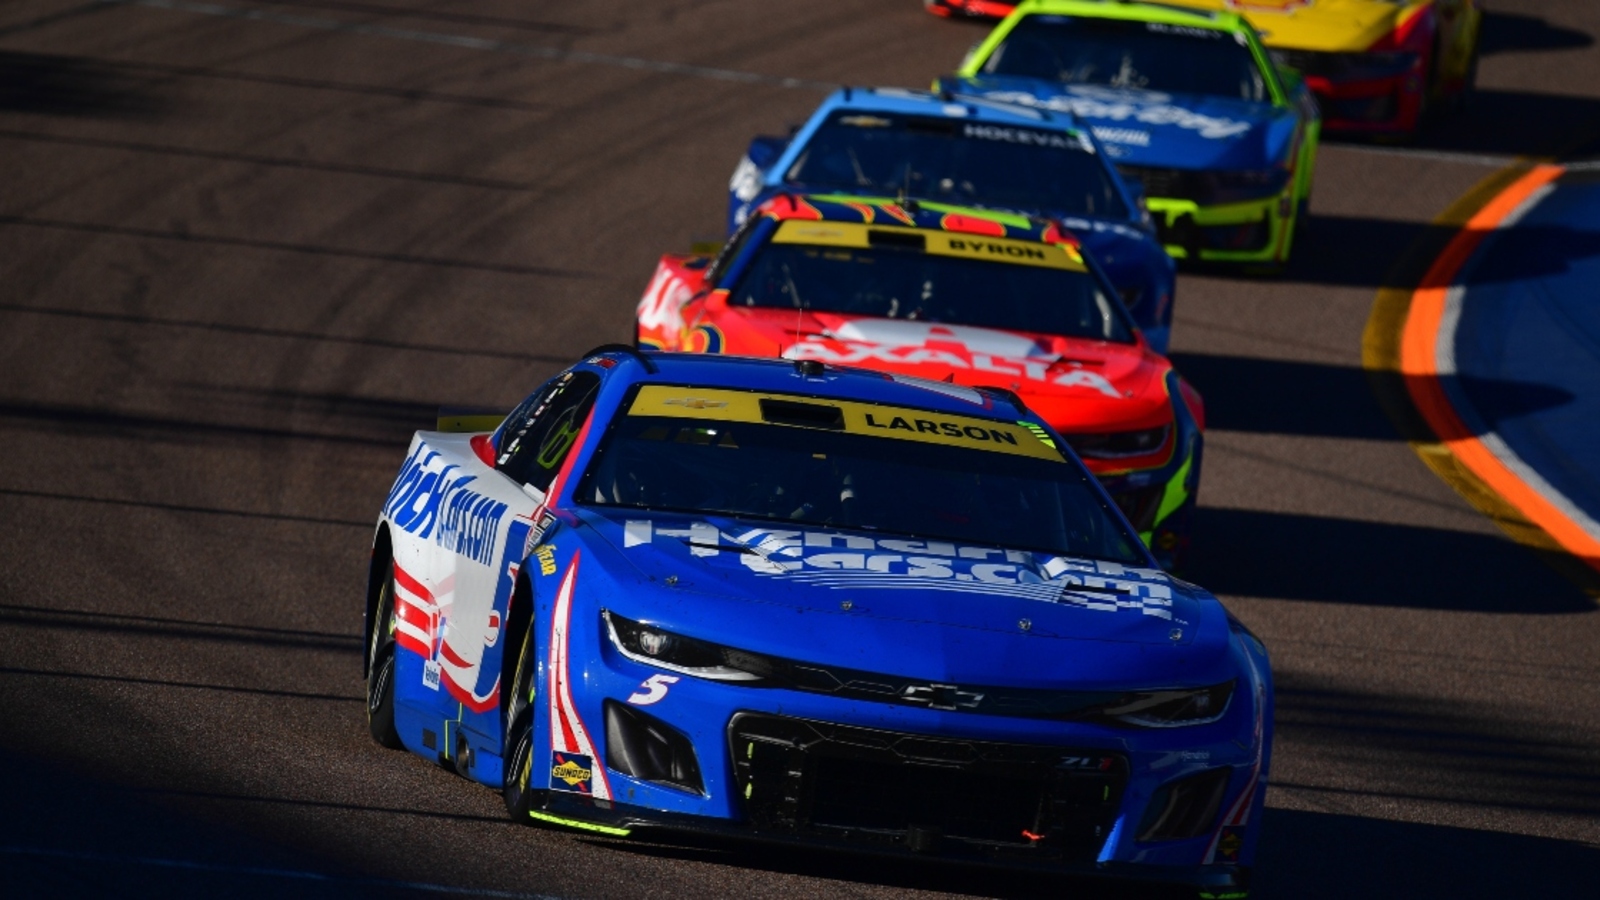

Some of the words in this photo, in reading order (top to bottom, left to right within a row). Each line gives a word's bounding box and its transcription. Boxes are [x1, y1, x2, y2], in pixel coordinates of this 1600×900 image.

[949, 238, 1045, 260] BYRON
[782, 342, 1123, 399] AXALTA
[865, 413, 1018, 445] LARSON
[627, 673, 680, 705] 5
[554, 766, 591, 780] SUNOCO
